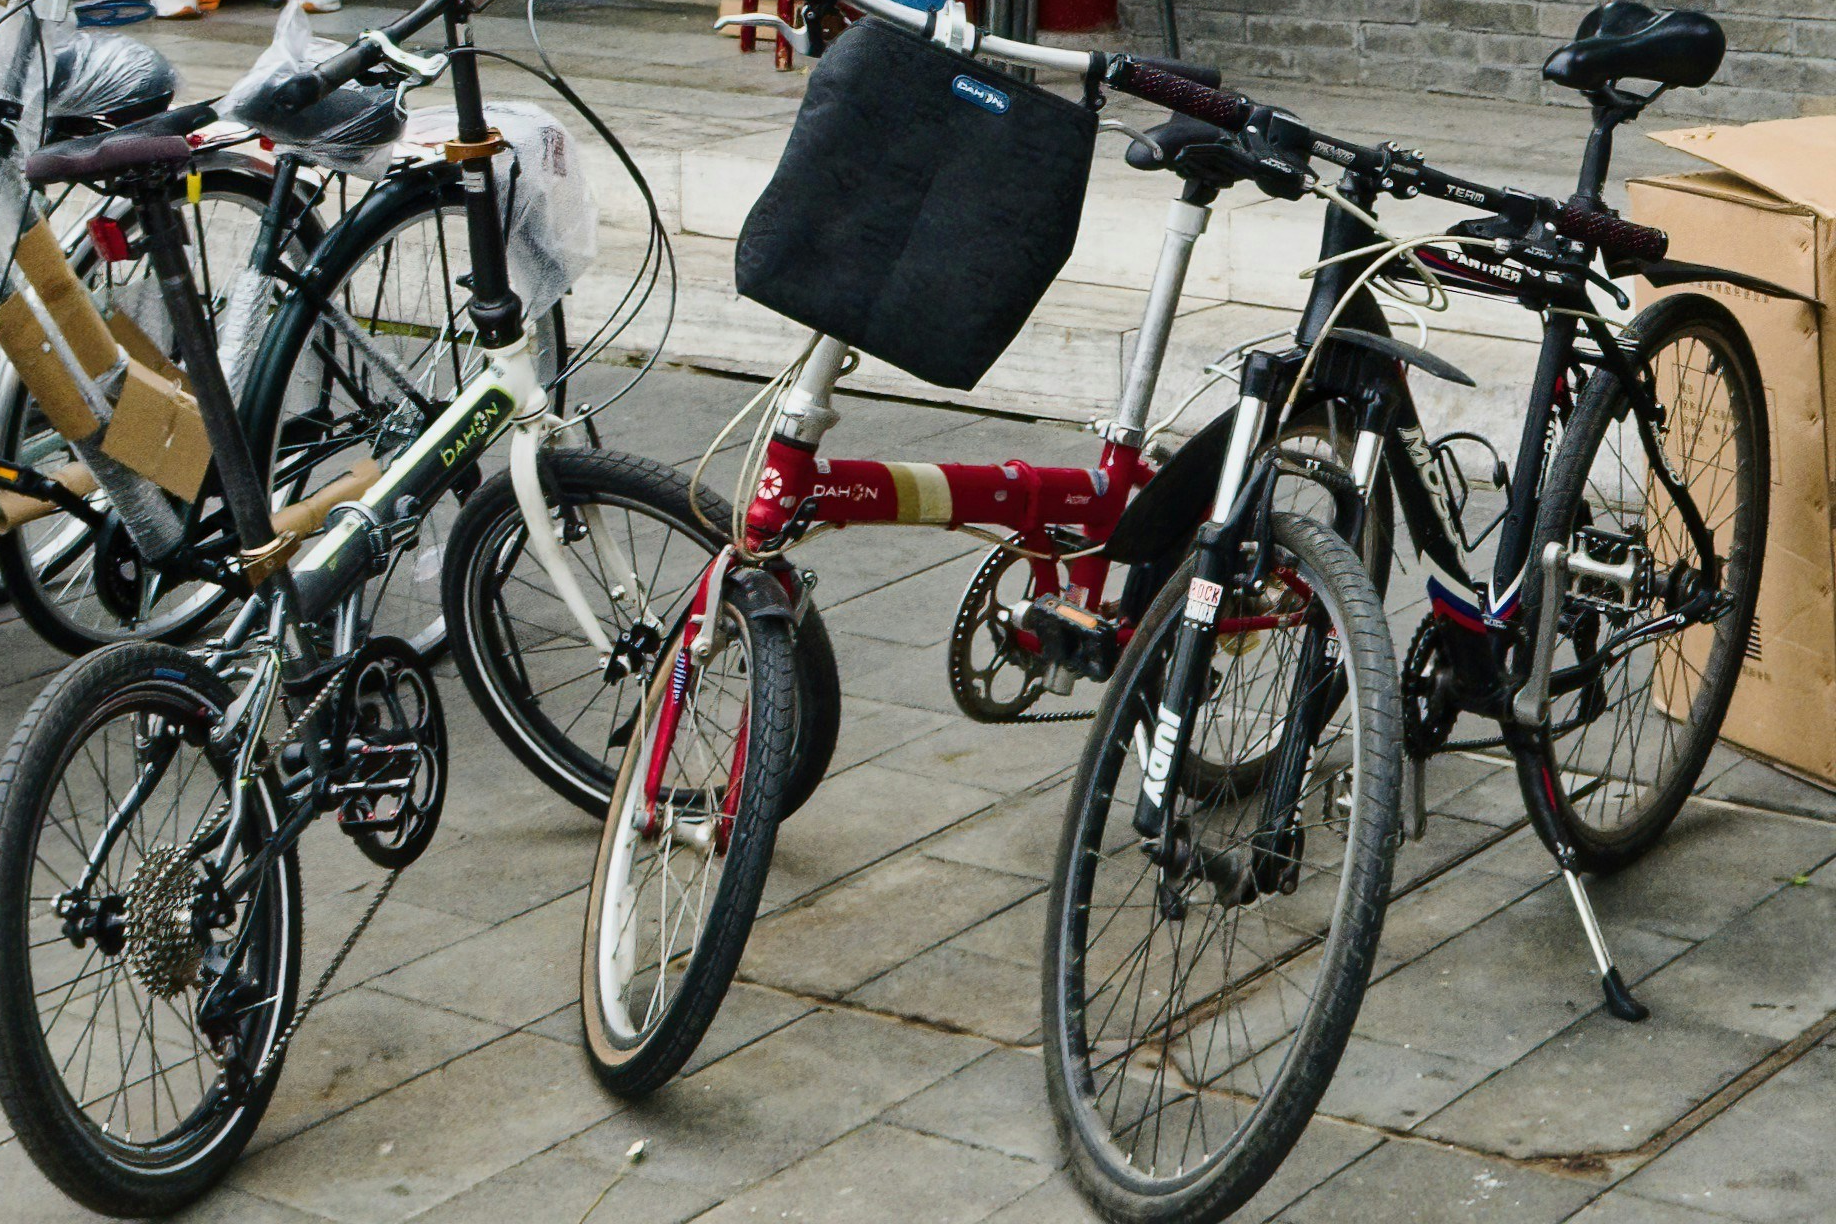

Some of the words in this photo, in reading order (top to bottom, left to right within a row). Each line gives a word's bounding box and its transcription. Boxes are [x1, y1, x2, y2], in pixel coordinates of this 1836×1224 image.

[1446, 250, 1522, 284] PANTHER
[440, 401, 499, 468] DAHON
[813, 484, 879, 502] DAHON
[1143, 702, 1182, 809] JUDY
